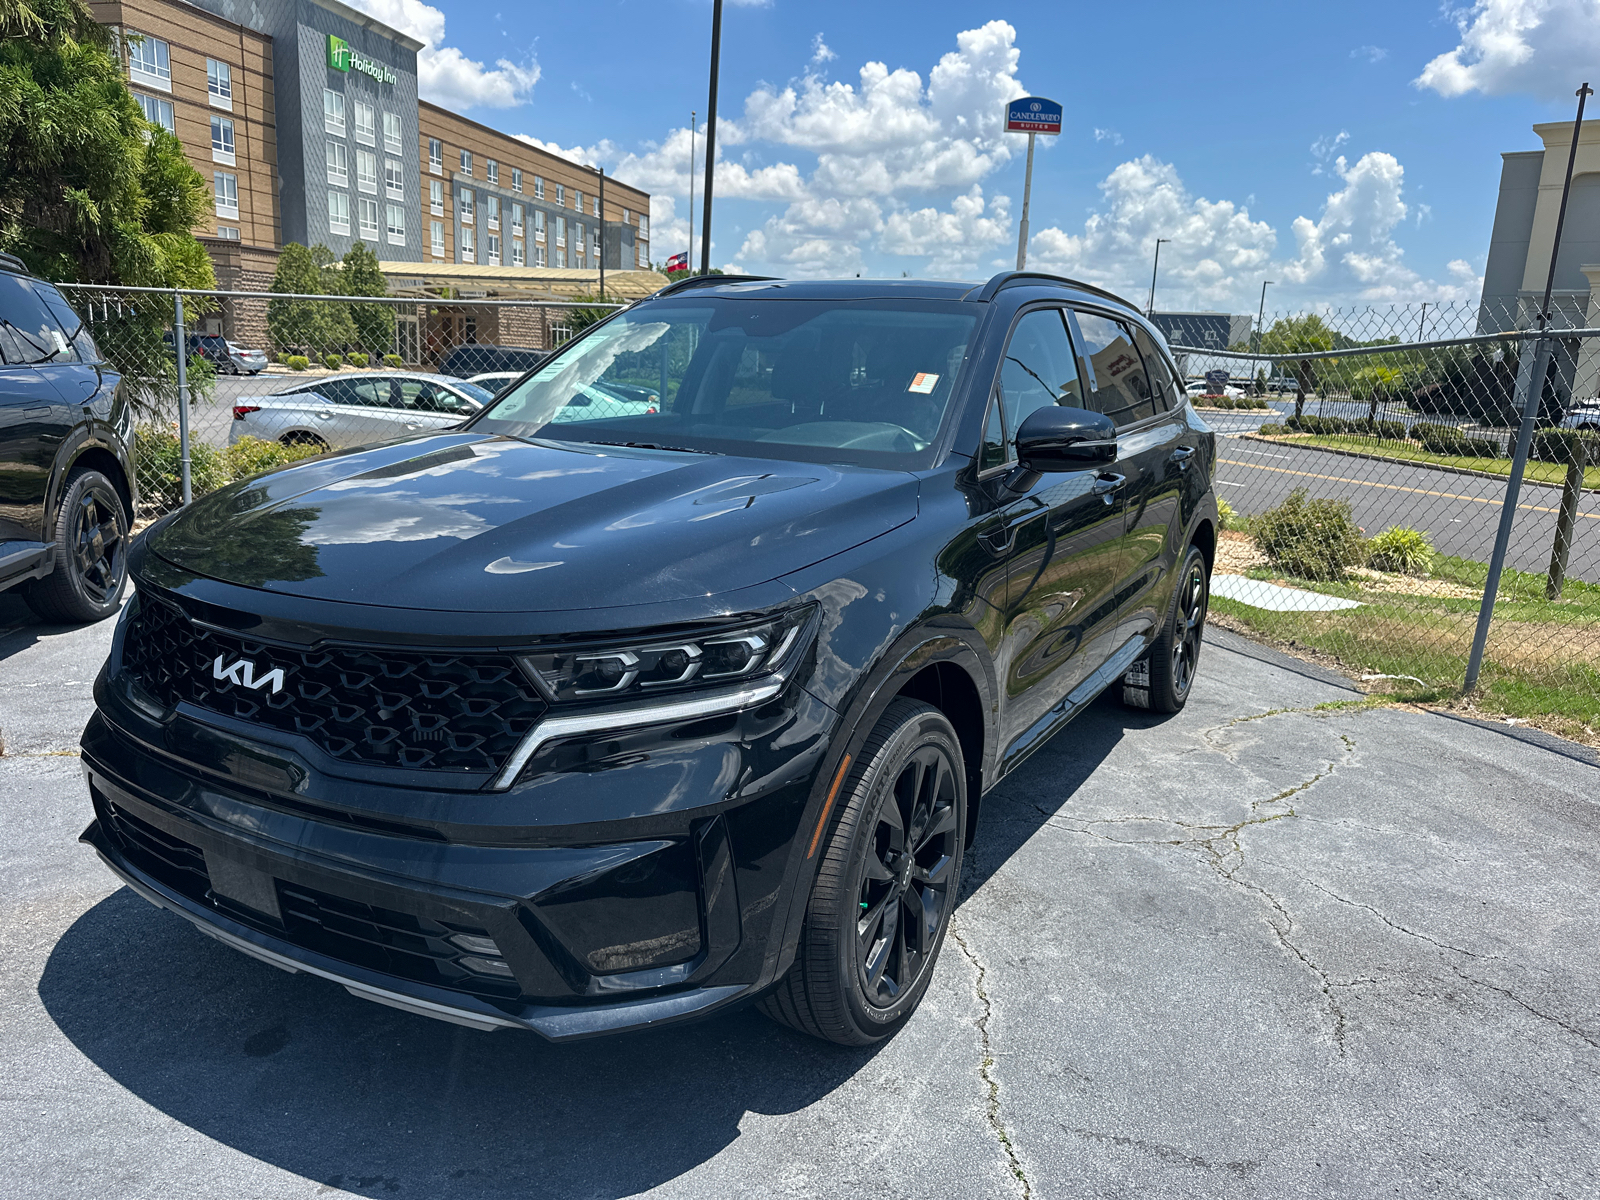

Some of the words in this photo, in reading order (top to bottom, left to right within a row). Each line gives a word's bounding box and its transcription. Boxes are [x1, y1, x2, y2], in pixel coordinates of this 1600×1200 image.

[348, 52, 384, 83] Holiday
[384, 66, 397, 85] Inn
[213, 654, 284, 695] KIA
[853, 765, 892, 866] VELOCITY
[889, 740, 907, 766] SPORT
